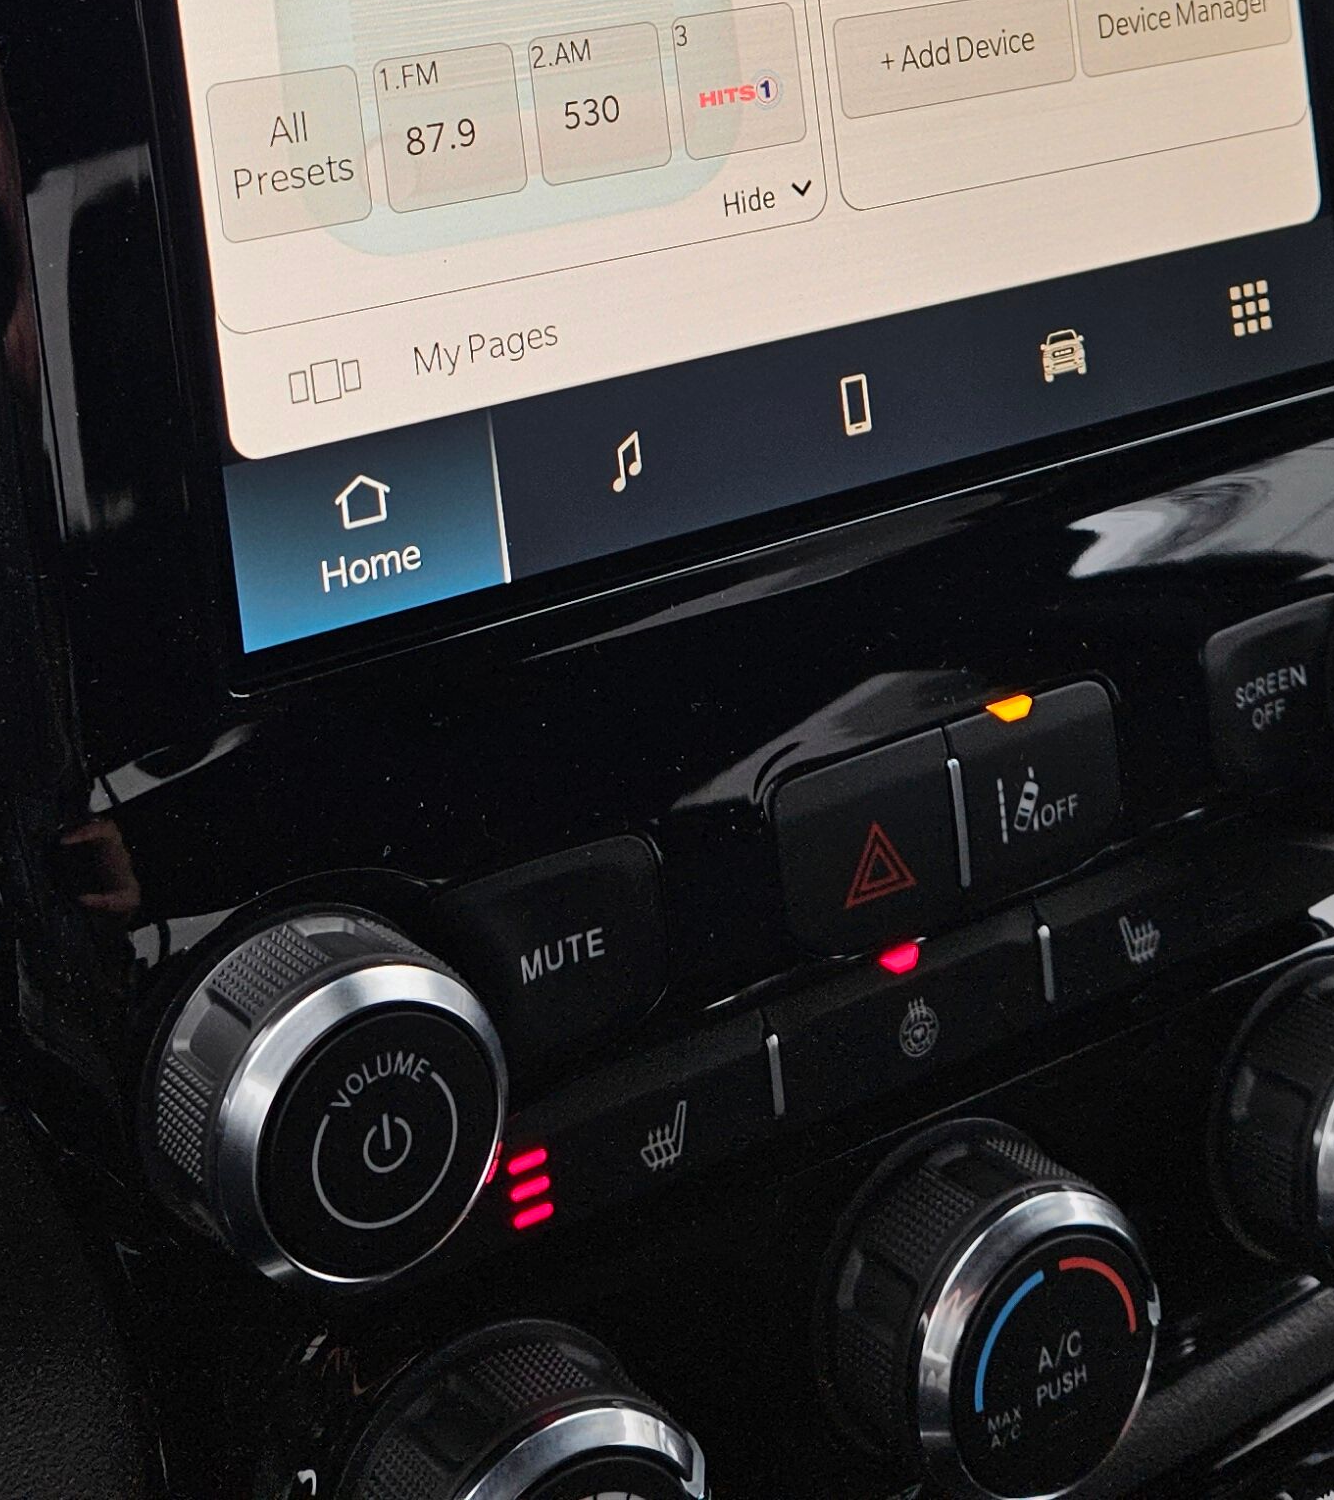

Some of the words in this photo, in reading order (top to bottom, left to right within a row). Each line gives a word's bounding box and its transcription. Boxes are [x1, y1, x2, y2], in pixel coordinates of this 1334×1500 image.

[674, 25, 688, 48] 3
[1097, 5, 1172, 39] Device
[531, 38, 592, 70] 2.AM
[900, 37, 952, 72] Add
[955, 28, 1037, 64] Device
[378, 61, 439, 91] 1.FM
[269, 111, 309, 147] All
[563, 95, 621, 131] 530
[406, 118, 478, 156] 87.9
[232, 154, 356, 200] Presets
[723, 187, 776, 217] Hide
[414, 342, 461, 376] My
[469, 321, 559, 366] Pages
[321, 543, 423, 593] Home
[1235, 664, 1307, 709] SCREEN
[1251, 698, 1286, 730] OFF
[1041, 793, 1079, 828] OFF
[520, 927, 606, 984] MUTE
[330, 1050, 430, 1112] VOLUME
[1038, 1329, 1083, 1375] A/C
[1036, 1363, 1088, 1409] PUSH
[987, 1403, 1022, 1434] MAX
